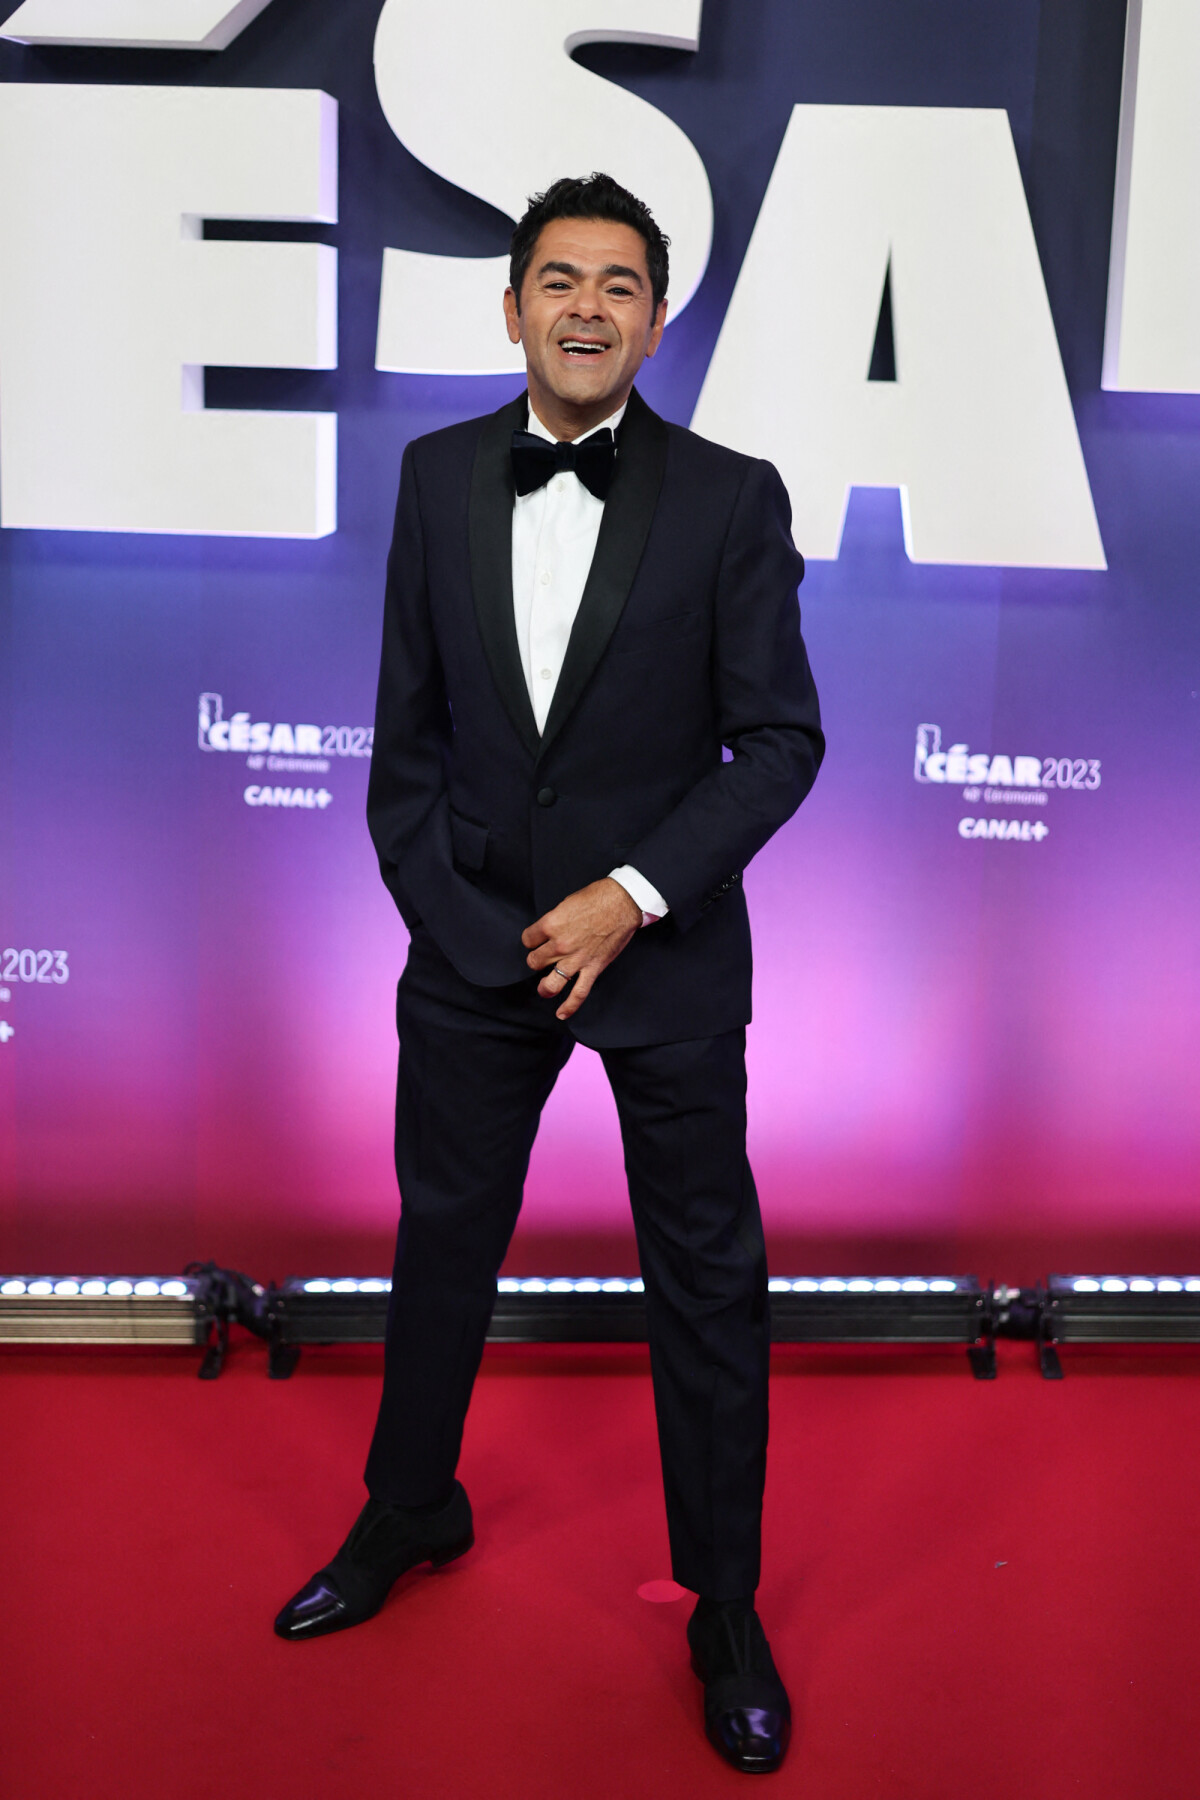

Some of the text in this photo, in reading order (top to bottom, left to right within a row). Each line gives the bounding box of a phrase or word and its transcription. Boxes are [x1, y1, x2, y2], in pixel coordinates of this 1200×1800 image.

[208, 711, 323, 754] CÉSAR
[925, 743, 1102, 790] CÉSAR 2023
[243, 784, 333, 809] CANAL+
[957, 817, 1050, 842] CANAL+
